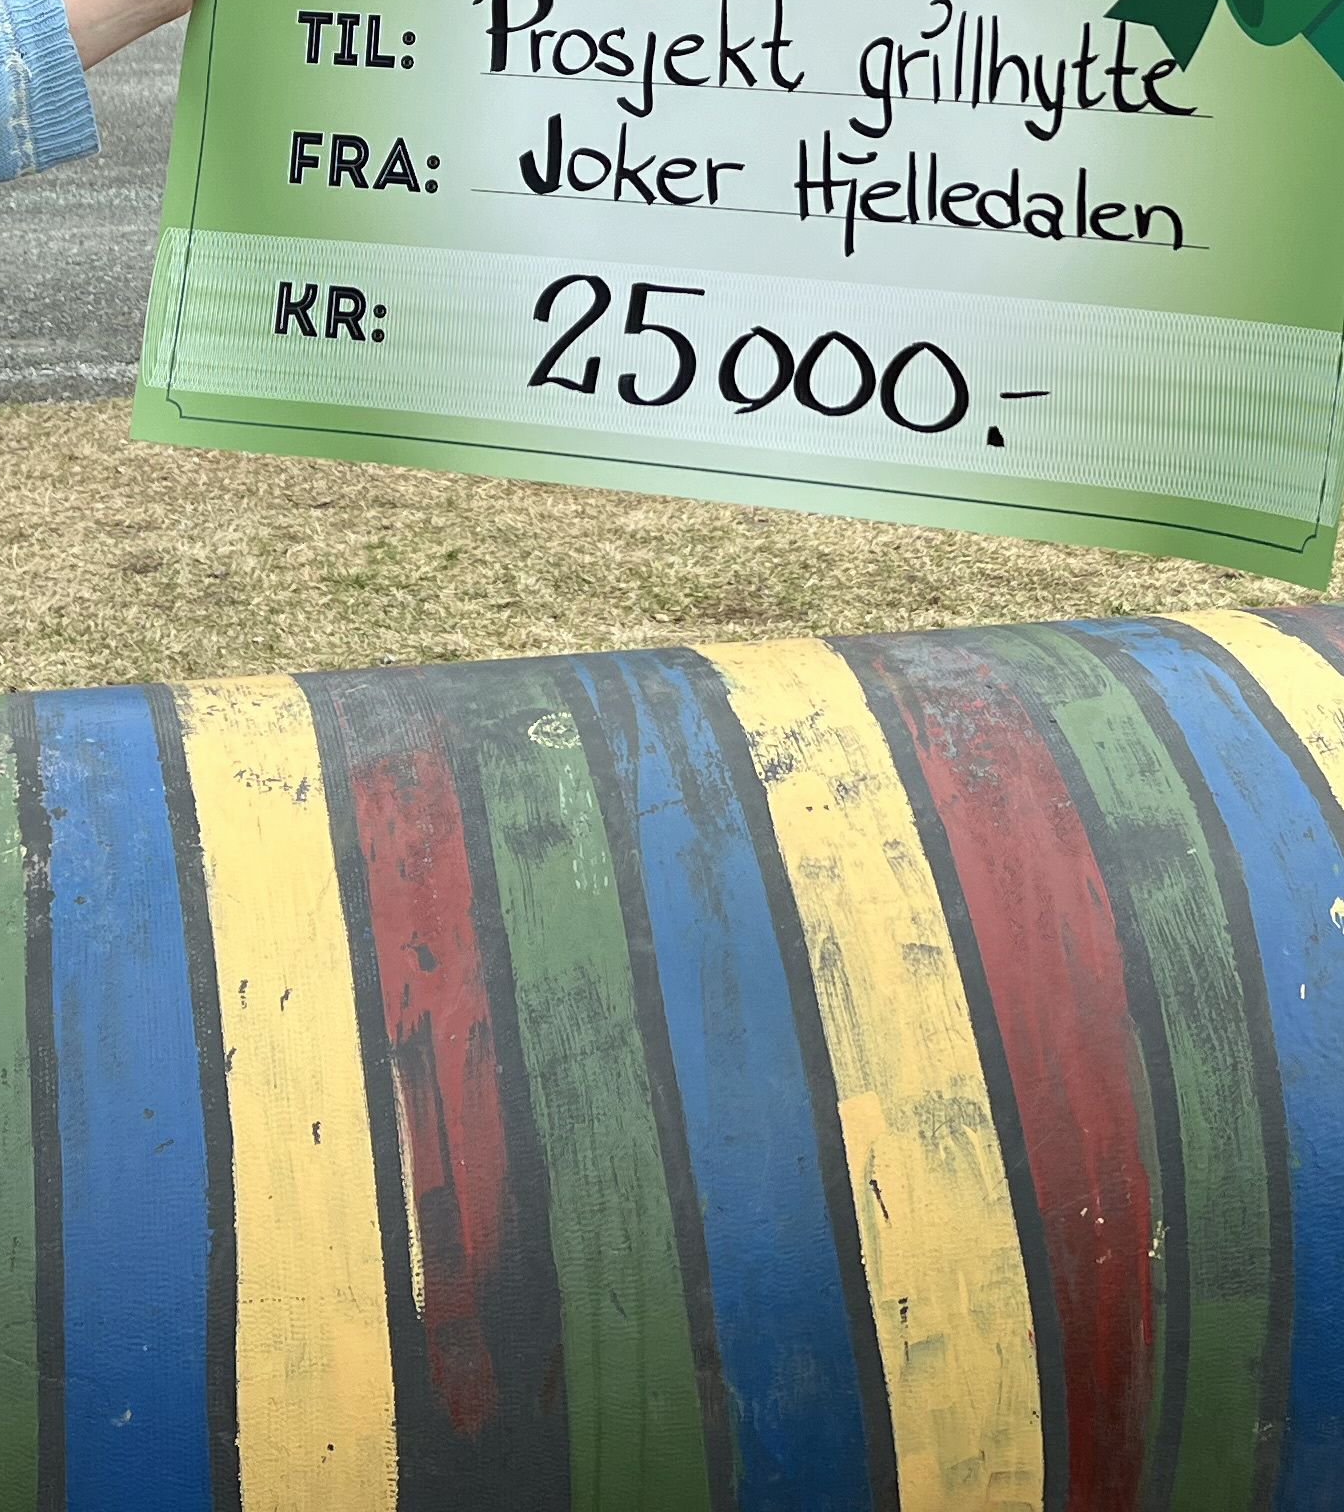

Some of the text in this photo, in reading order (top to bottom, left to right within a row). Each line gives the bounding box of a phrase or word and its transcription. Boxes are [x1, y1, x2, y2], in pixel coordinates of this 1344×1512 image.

[297, 9, 416, 70] TIL:
[288, 112, 1184, 258] FRA: Joker Hjelledalen
[273, 281, 388, 343] KR:
